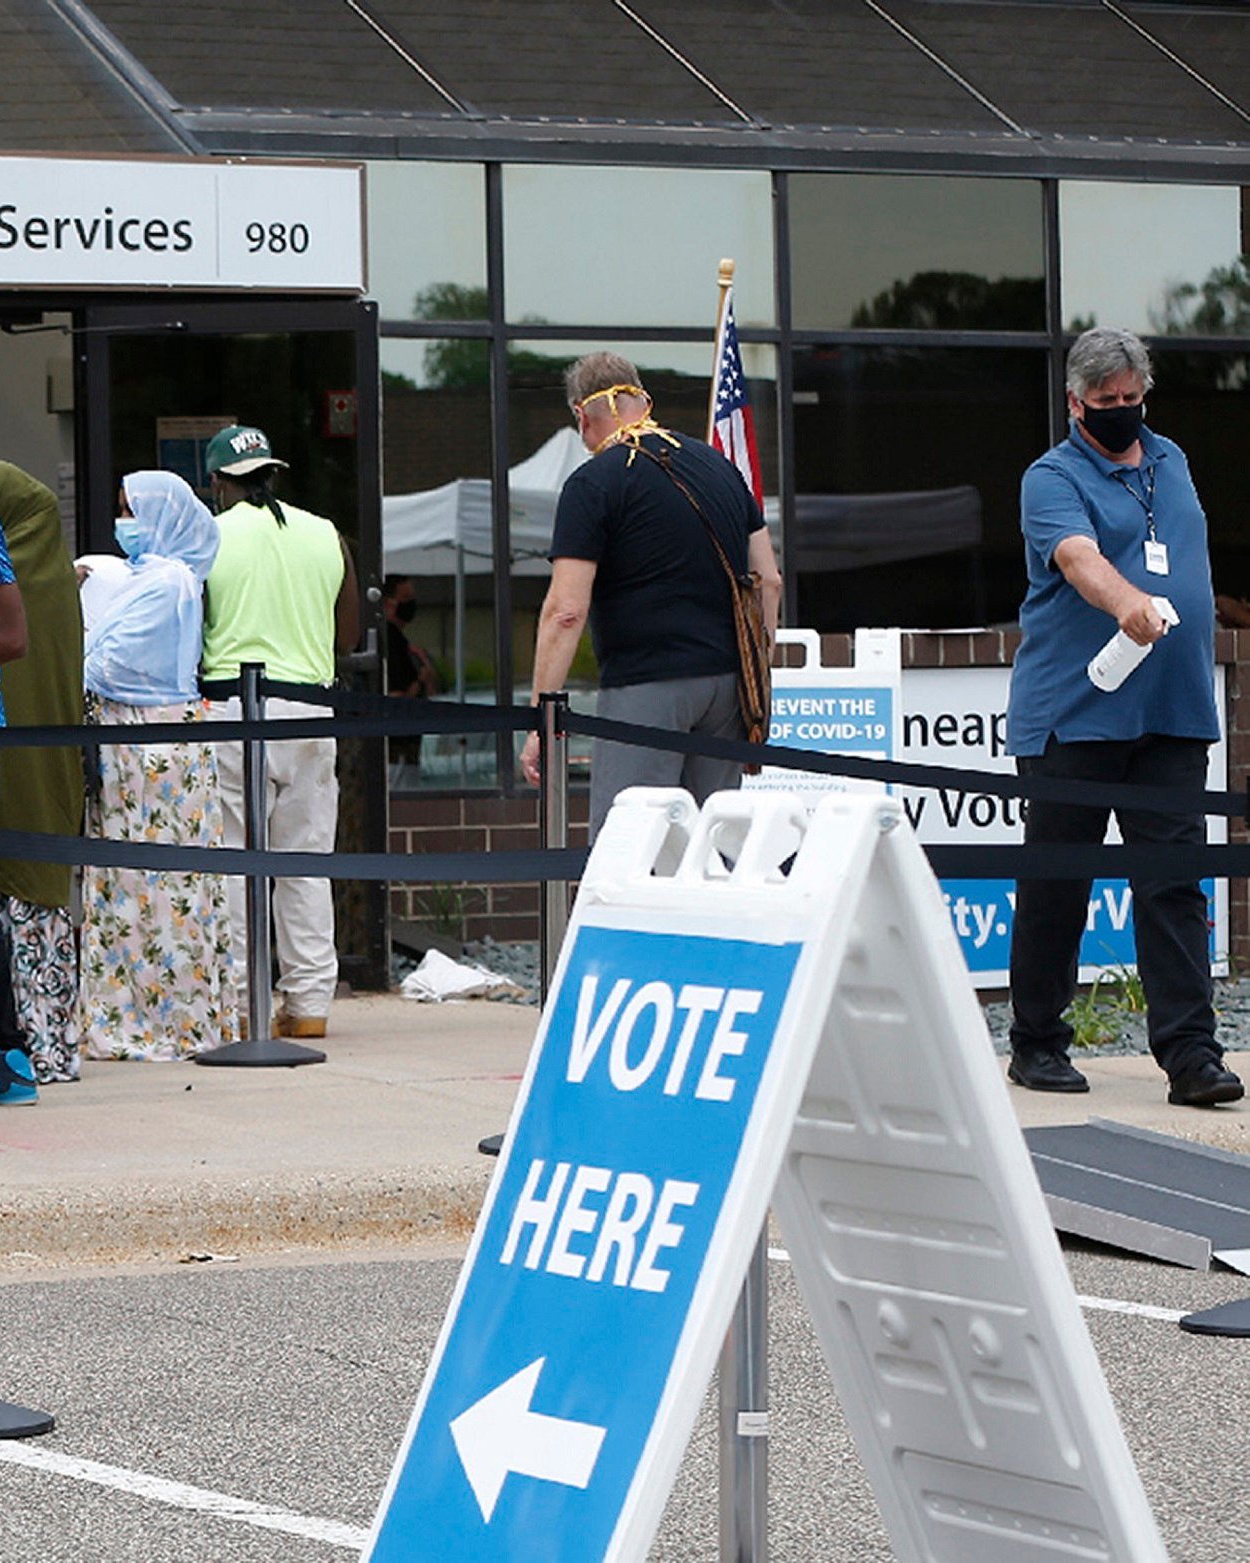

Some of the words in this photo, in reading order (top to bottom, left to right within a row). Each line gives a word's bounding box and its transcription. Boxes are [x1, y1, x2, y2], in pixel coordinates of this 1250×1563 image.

[245, 222, 310, 254] 980
[838, 698, 876, 716] THE
[770, 722, 793, 739] OF
[796, 723, 886, 740] COVID-19
[566, 975, 764, 1101] VOTE
[500, 1158, 700, 1293] HERE
